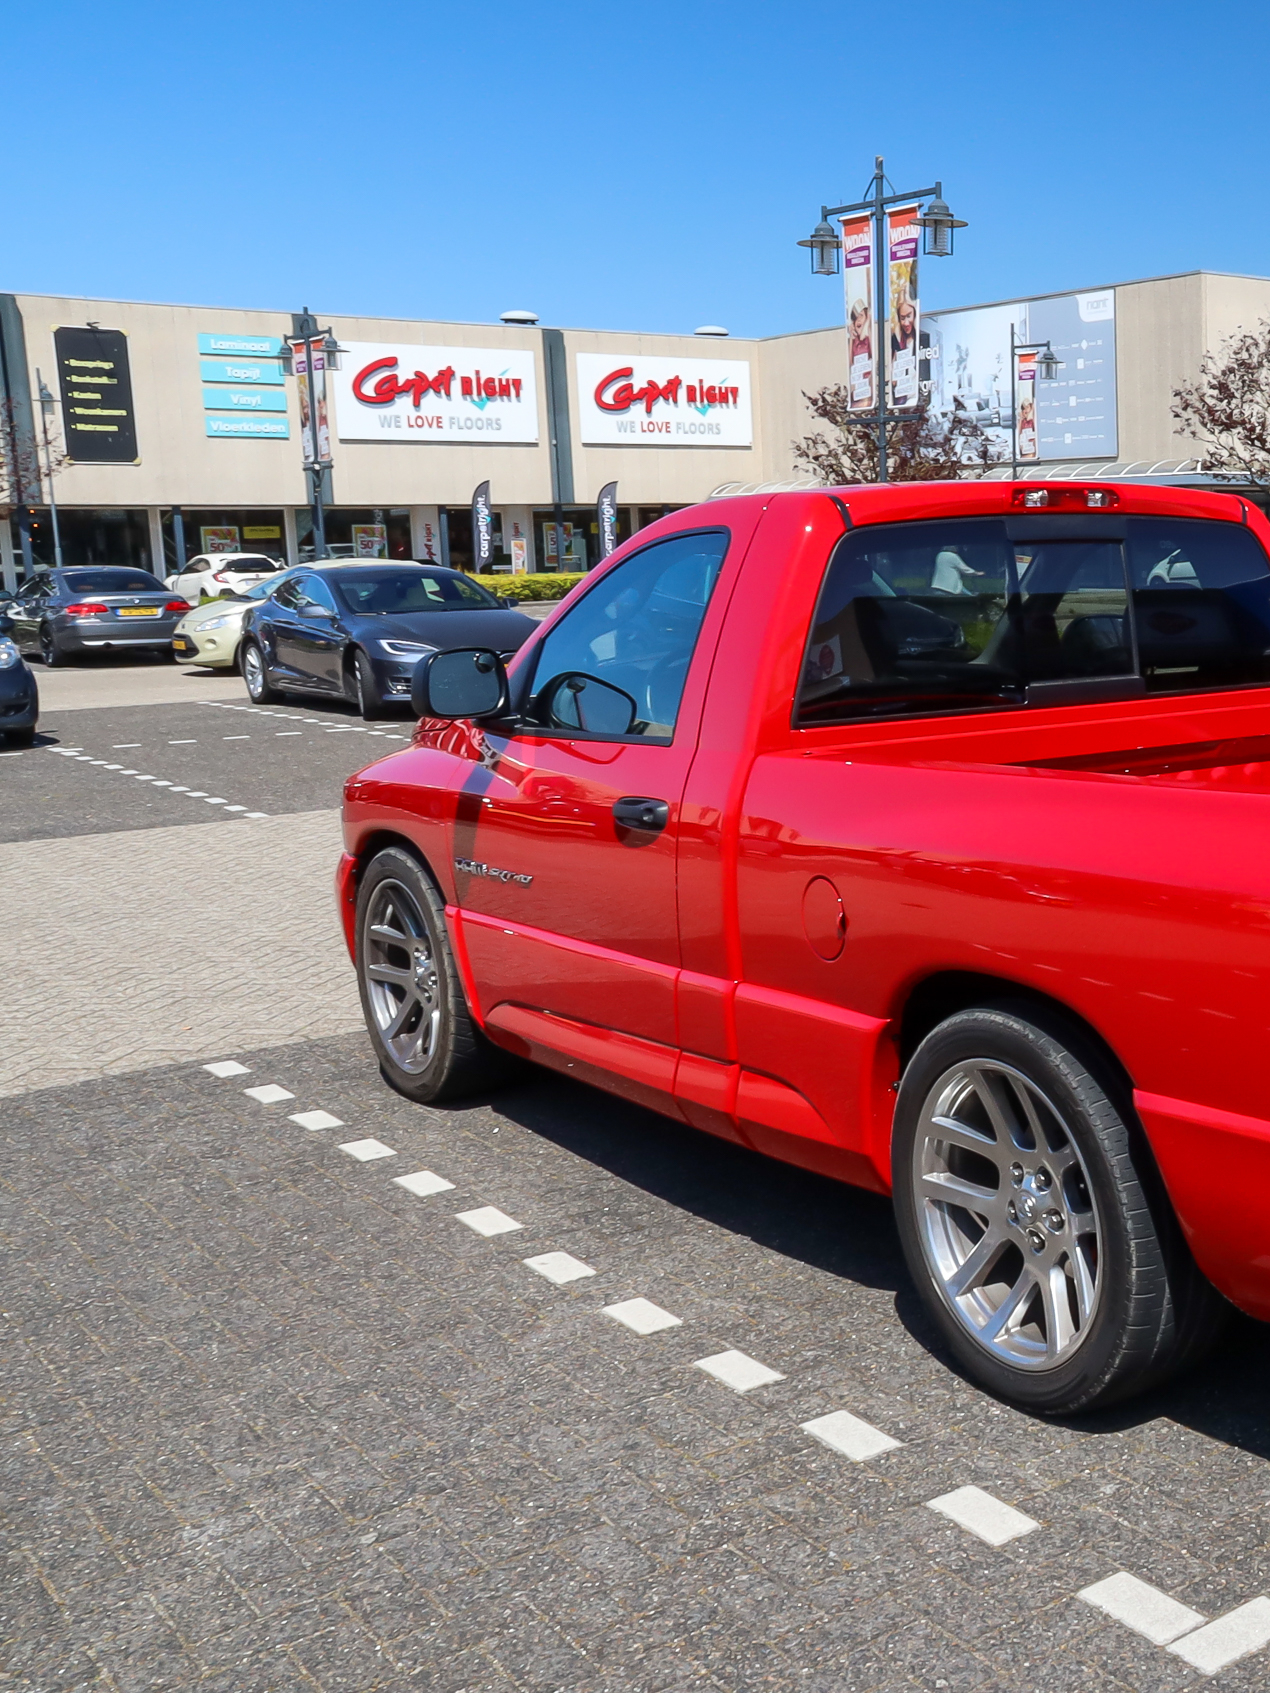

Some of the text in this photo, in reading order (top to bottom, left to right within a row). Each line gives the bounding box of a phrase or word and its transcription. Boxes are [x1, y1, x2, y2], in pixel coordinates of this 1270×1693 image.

[209, 338, 271, 352] Laminaat
[225, 366, 261, 381] Tapijt
[351, 356, 456, 408] Carpet
[594, 366, 683, 414] Carpet
[229, 393, 262, 407] Vinyl
[209, 420, 287, 434] Vloerkleden
[378, 414, 503, 431] WE LOVE FLOORS
[616, 420, 722, 435] WE LOVE FLOORS
